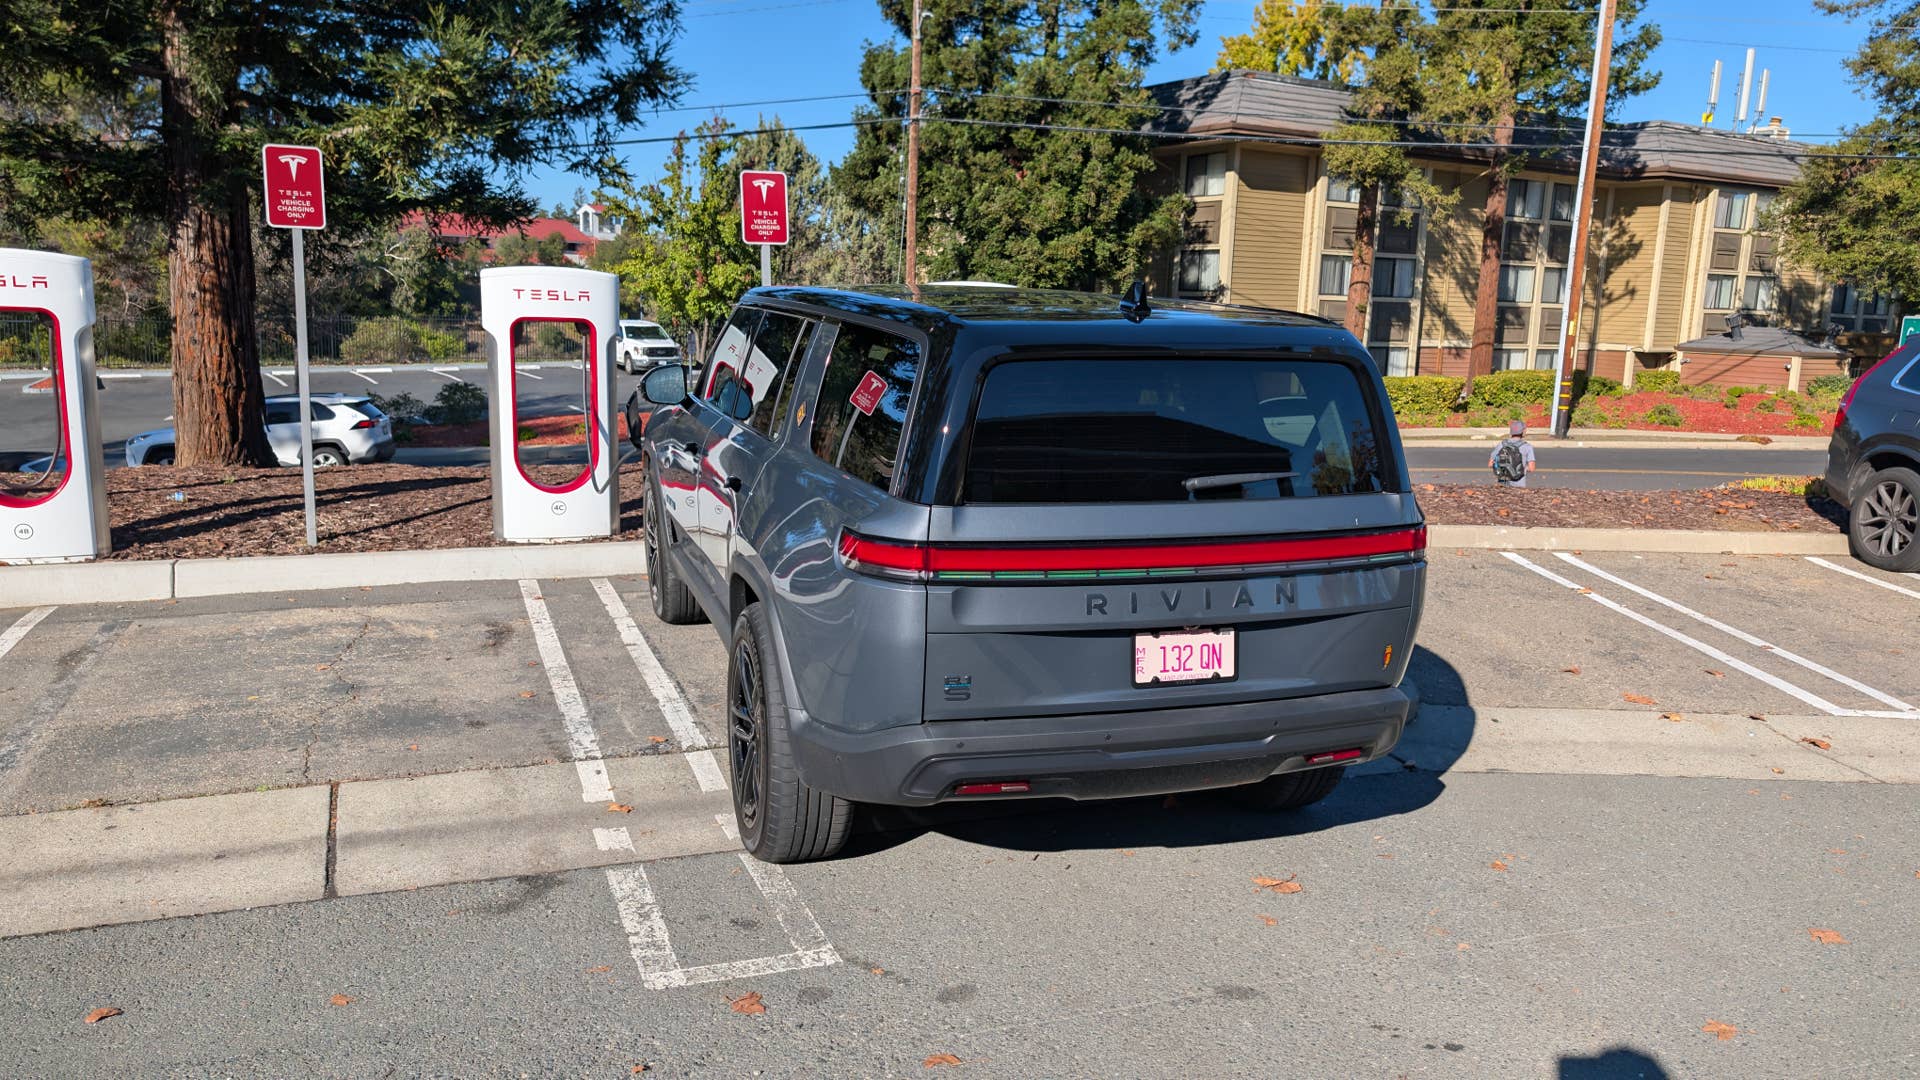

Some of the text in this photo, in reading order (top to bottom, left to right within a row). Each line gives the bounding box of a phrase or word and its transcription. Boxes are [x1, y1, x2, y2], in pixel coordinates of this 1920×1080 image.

[278, 189, 312, 197] TESLA
[277, 205, 315, 213] CHARGING
[512, 288, 590, 302] TESLA
[1086, 582, 1295, 616] RIVIAN
[1160, 643, 1222, 673] 132 QN
